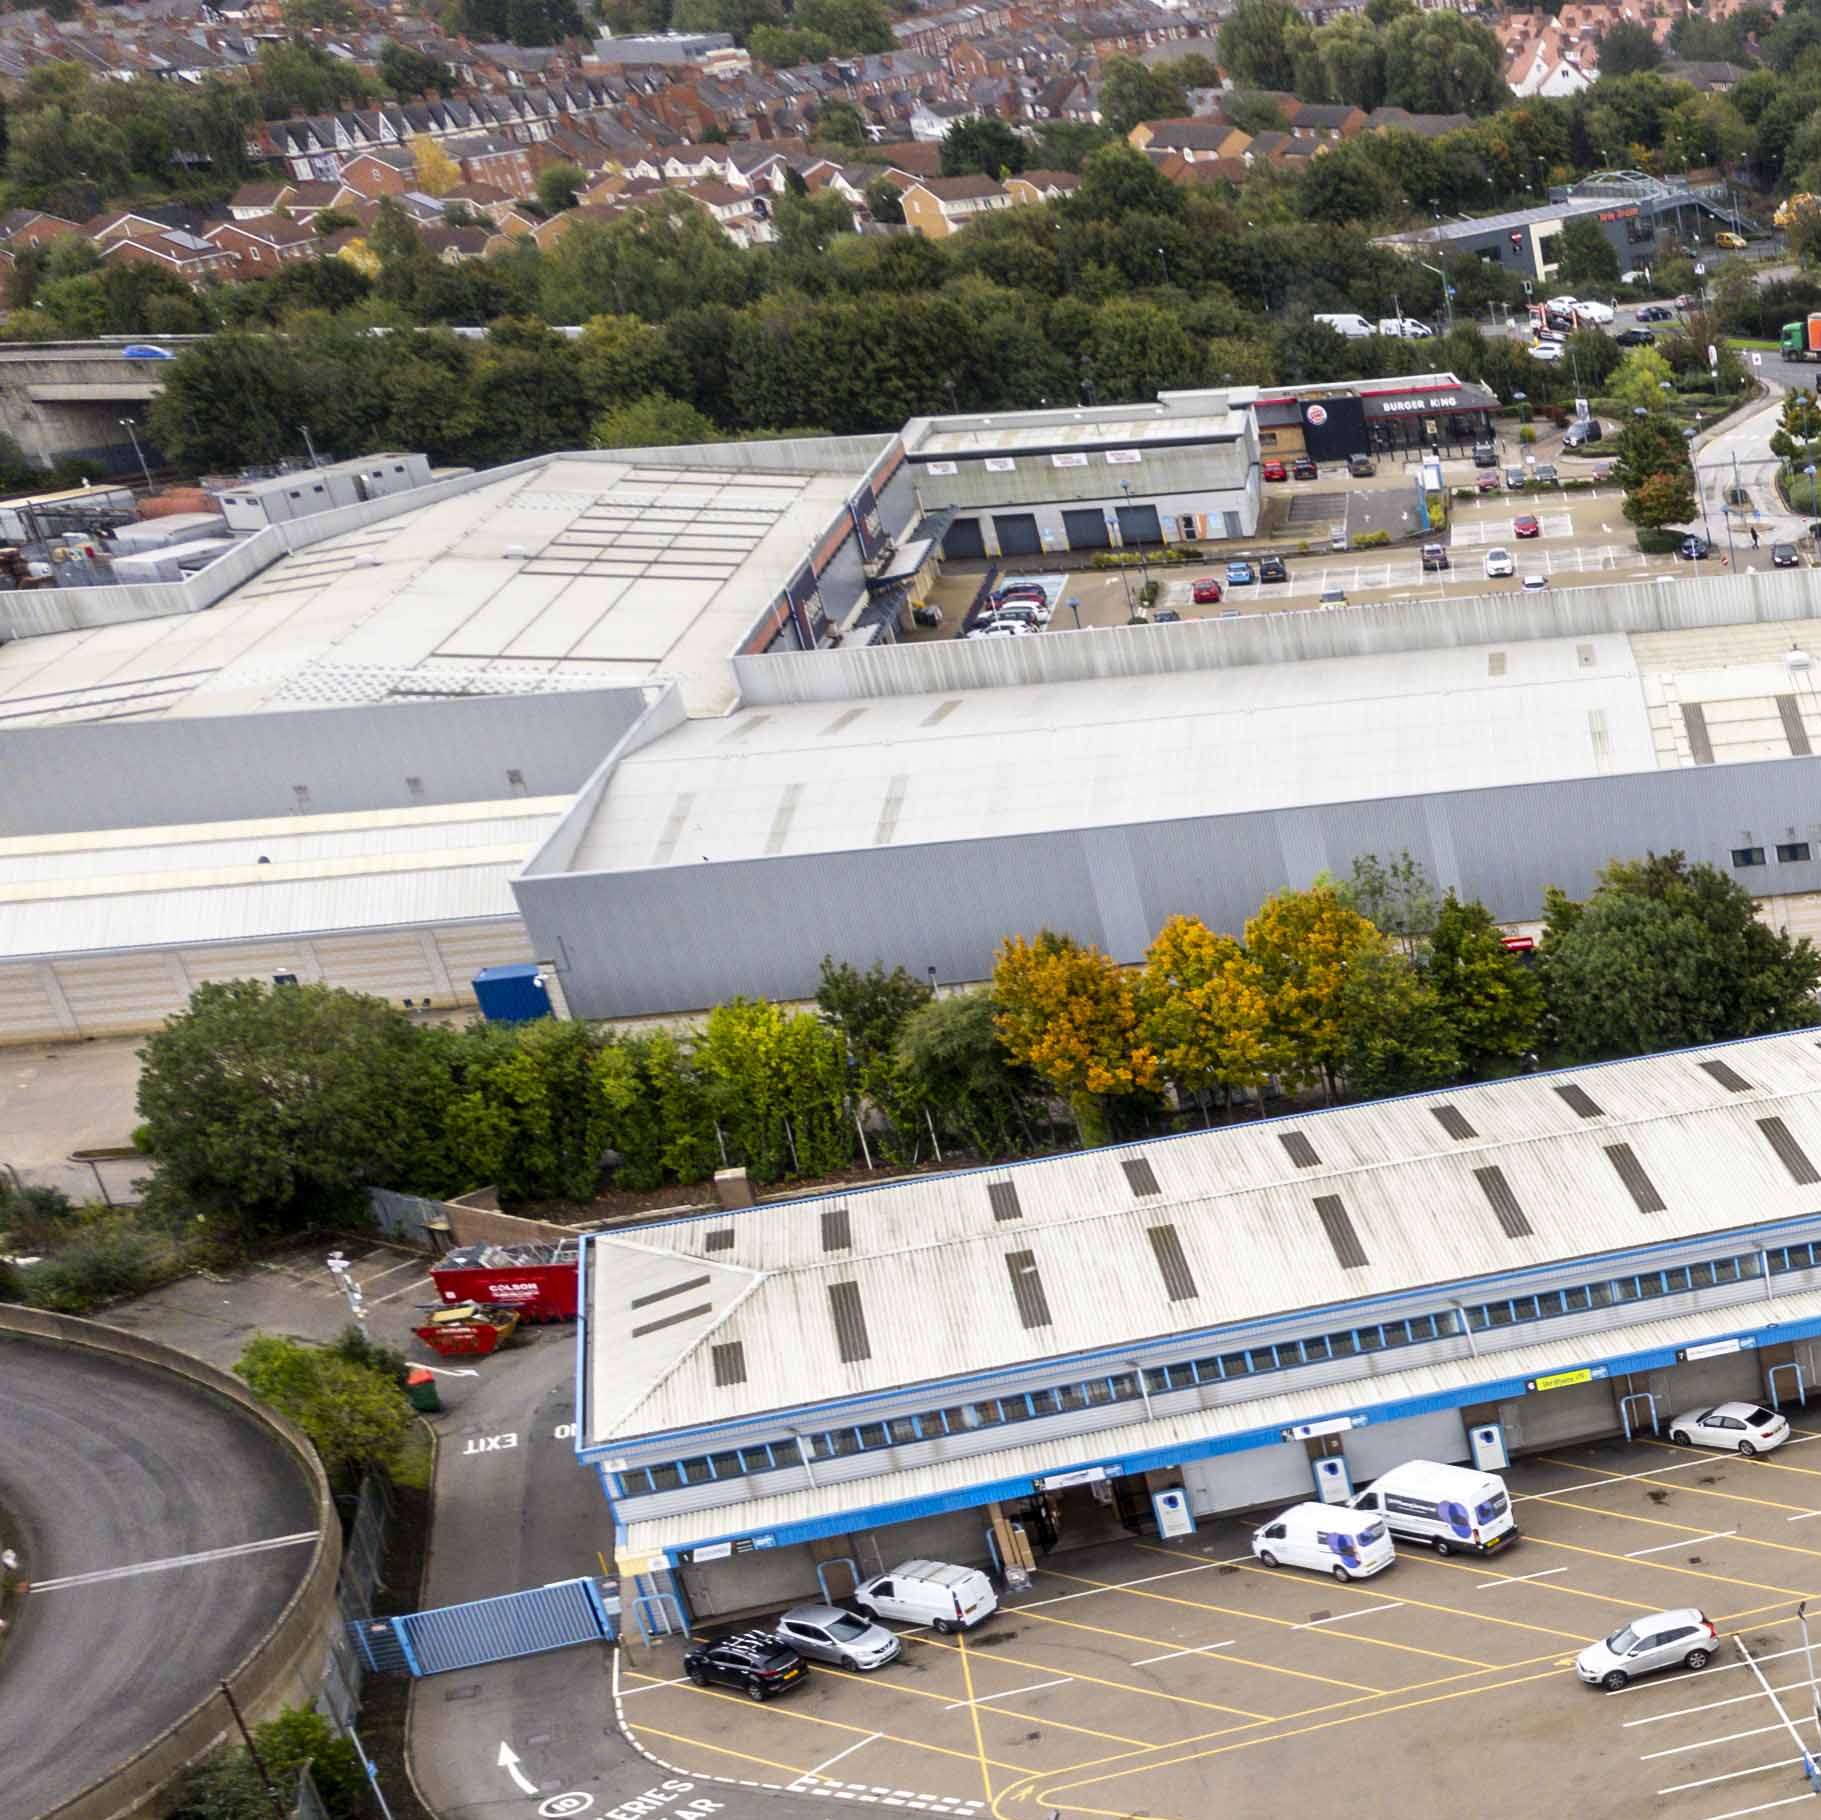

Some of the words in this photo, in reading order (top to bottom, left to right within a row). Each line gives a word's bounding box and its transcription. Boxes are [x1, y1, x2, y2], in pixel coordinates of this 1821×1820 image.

[1383, 401, 1426, 412] BURGER
[1429, 398, 1457, 408] KING
[463, 1433, 518, 1455] EXIT
